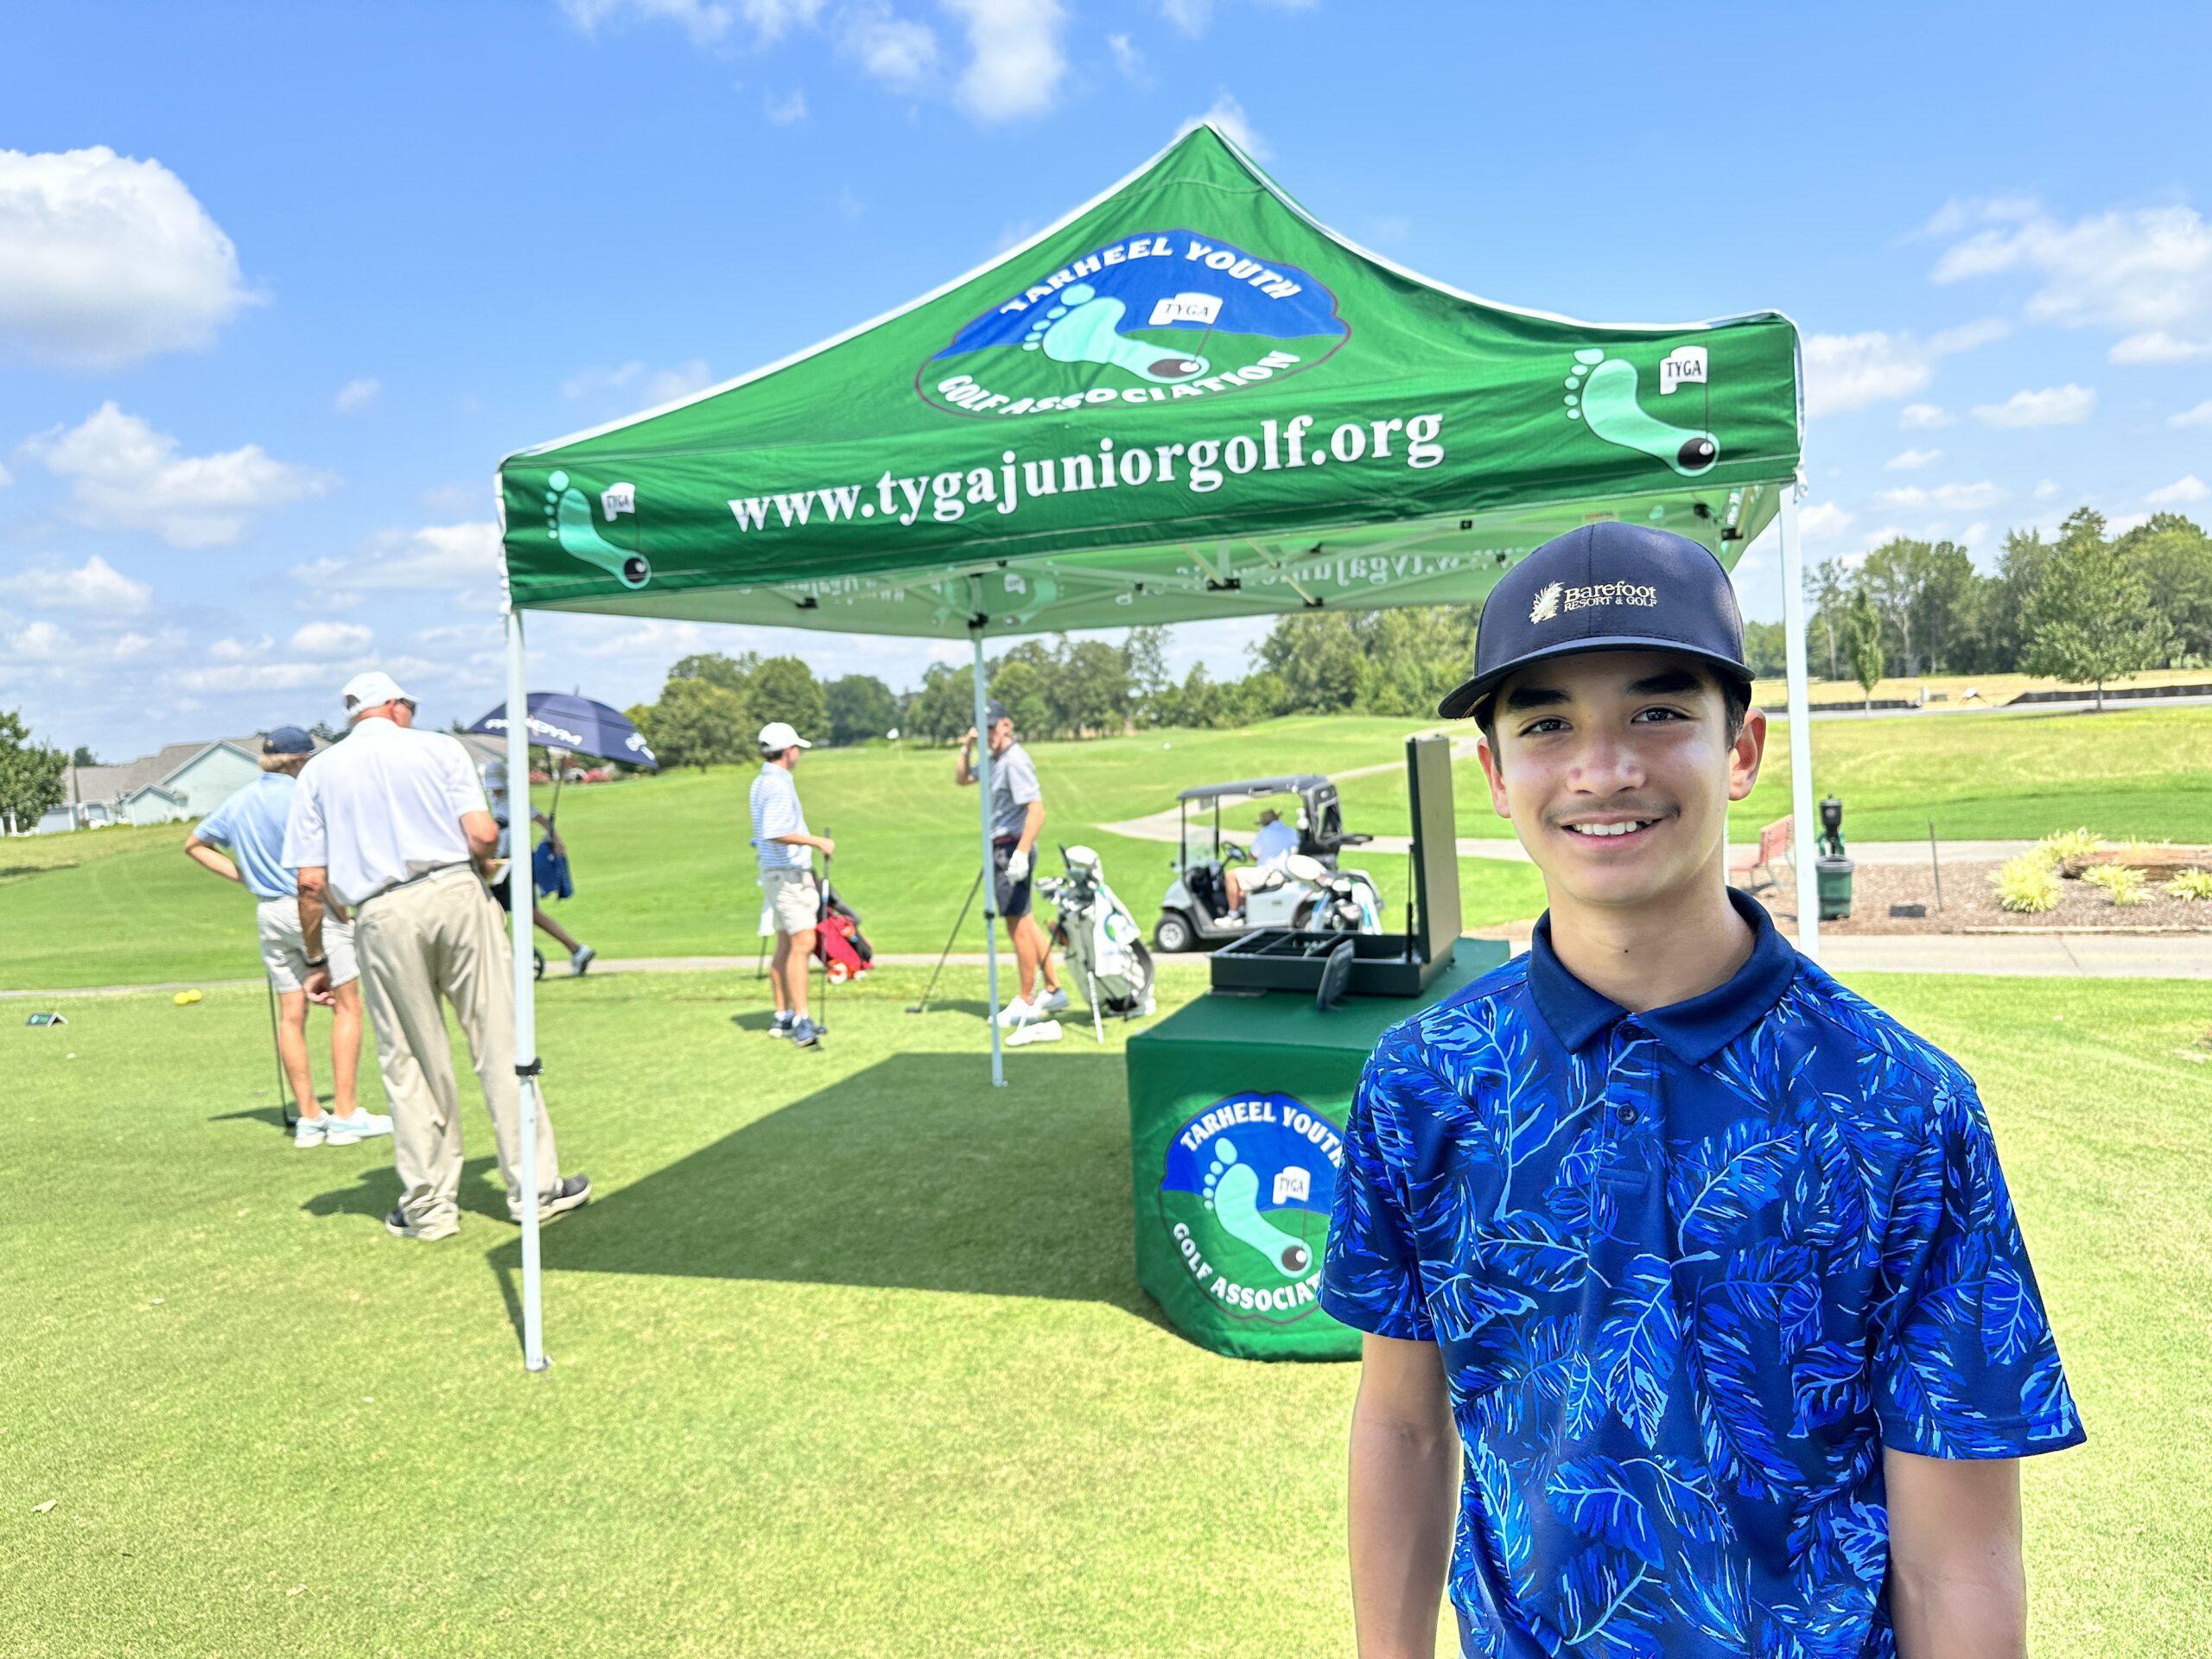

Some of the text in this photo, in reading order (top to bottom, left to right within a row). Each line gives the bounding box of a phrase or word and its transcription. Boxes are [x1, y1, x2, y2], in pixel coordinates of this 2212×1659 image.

[1001, 237, 1302, 315] TARHEEL YOUTH
[1165, 303, 1210, 317] TYGA
[938, 350, 1301, 415] GOLF ASSOCIATION
[1666, 359, 1702, 378] TYGA
[727, 413, 1446, 532] www.tygajuniorgolf.org
[1564, 581, 1657, 604] Barefoot
[1564, 596, 1657, 613] RESORT & GOLF
[1180, 1102, 1277, 1153] TARHEEL
[1173, 1222, 1322, 1312] GOLF ASSOCIAT
